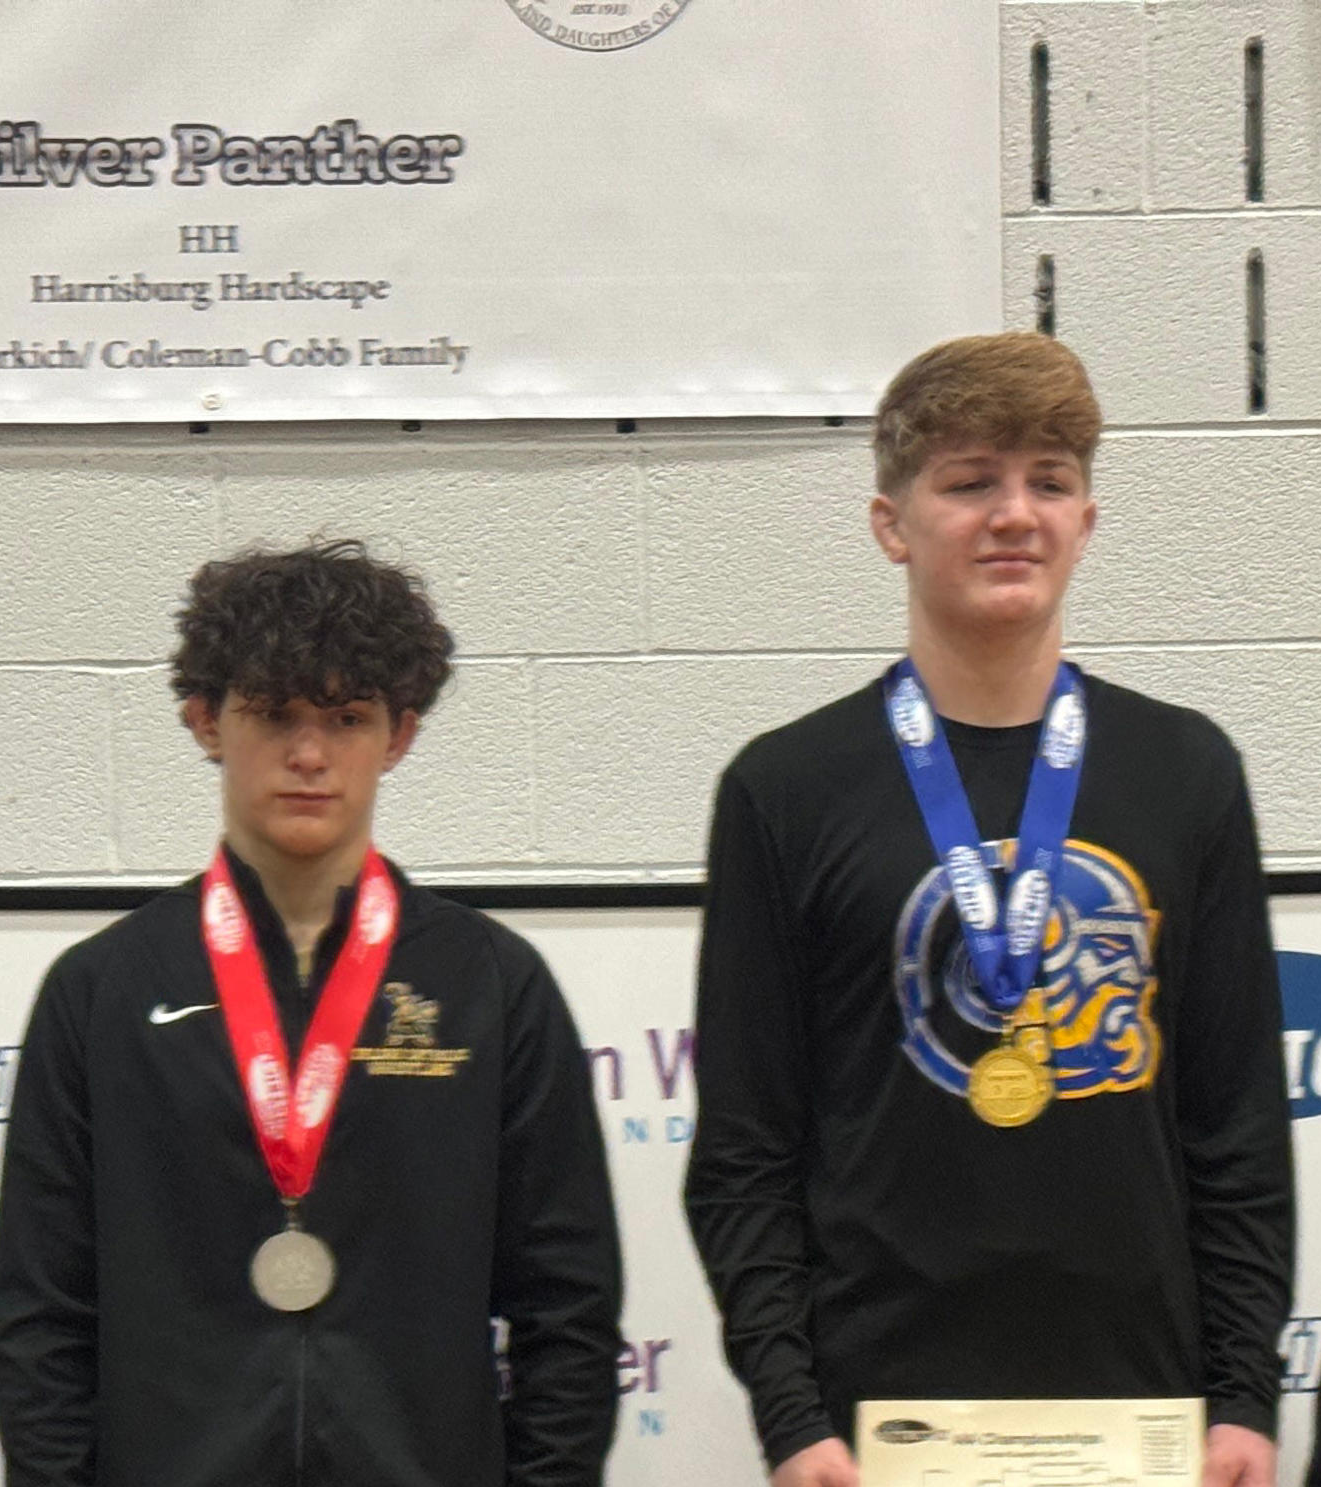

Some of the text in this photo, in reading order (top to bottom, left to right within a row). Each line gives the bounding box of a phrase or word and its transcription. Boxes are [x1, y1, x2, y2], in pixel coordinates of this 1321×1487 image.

[554, 20, 652, 47] DAUGHTERS
[652, 3, 674, 26] OF
[172, 119, 466, 186] Panther
[178, 225, 239, 254] HH
[30, 272, 392, 311] Harrisburg Hardscape
[100, 338, 352, 369] Coleman-Cobb
[358, 336, 471, 374] Family
